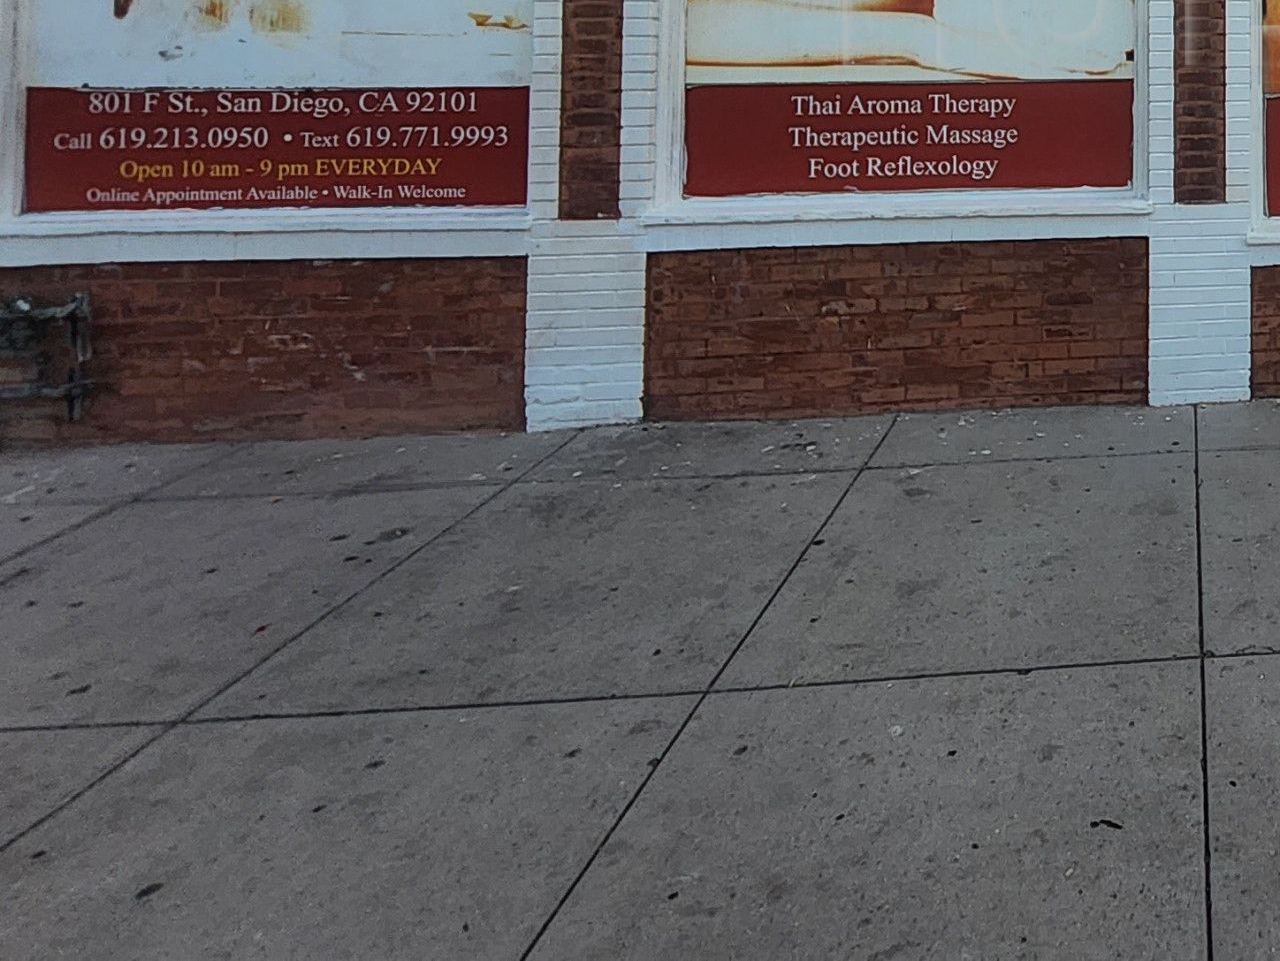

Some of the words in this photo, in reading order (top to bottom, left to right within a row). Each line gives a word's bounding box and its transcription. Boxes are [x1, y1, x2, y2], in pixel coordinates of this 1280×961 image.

[89, 93, 131, 112] 801
[144, 93, 159, 112] F
[168, 93, 207, 115] St.,
[217, 93, 261, 112] San
[271, 89, 350, 117] Diego,
[359, 92, 399, 112] CA
[407, 92, 475, 111] 92101
[791, 95, 840, 115] Thai
[848, 96, 922, 114] Aroma
[929, 94, 1016, 117] Therapy
[54, 133, 91, 149] Call
[100, 127, 268, 148] 619.213.0950
[300, 132, 339, 147] Text
[347, 126, 507, 146] 619.771.9993
[789, 125, 918, 150] Therapeutic
[927, 125, 1017, 148] Massage
[120, 161, 173, 182] Open
[183, 160, 204, 177] 10
[210, 165, 239, 176] am
[260, 159, 272, 176] 9
[278, 164, 308, 180] pm
[316, 158, 441, 175] EVERYDAY
[809, 159, 859, 177] Foot
[868, 155, 998, 179] Reflexology
[87, 188, 139, 202] Online
[143, 187, 242, 204] Appointment
[246, 186, 318, 200] Available
[334, 186, 392, 198] Walk-In
[398, 185, 465, 198] Welcome
